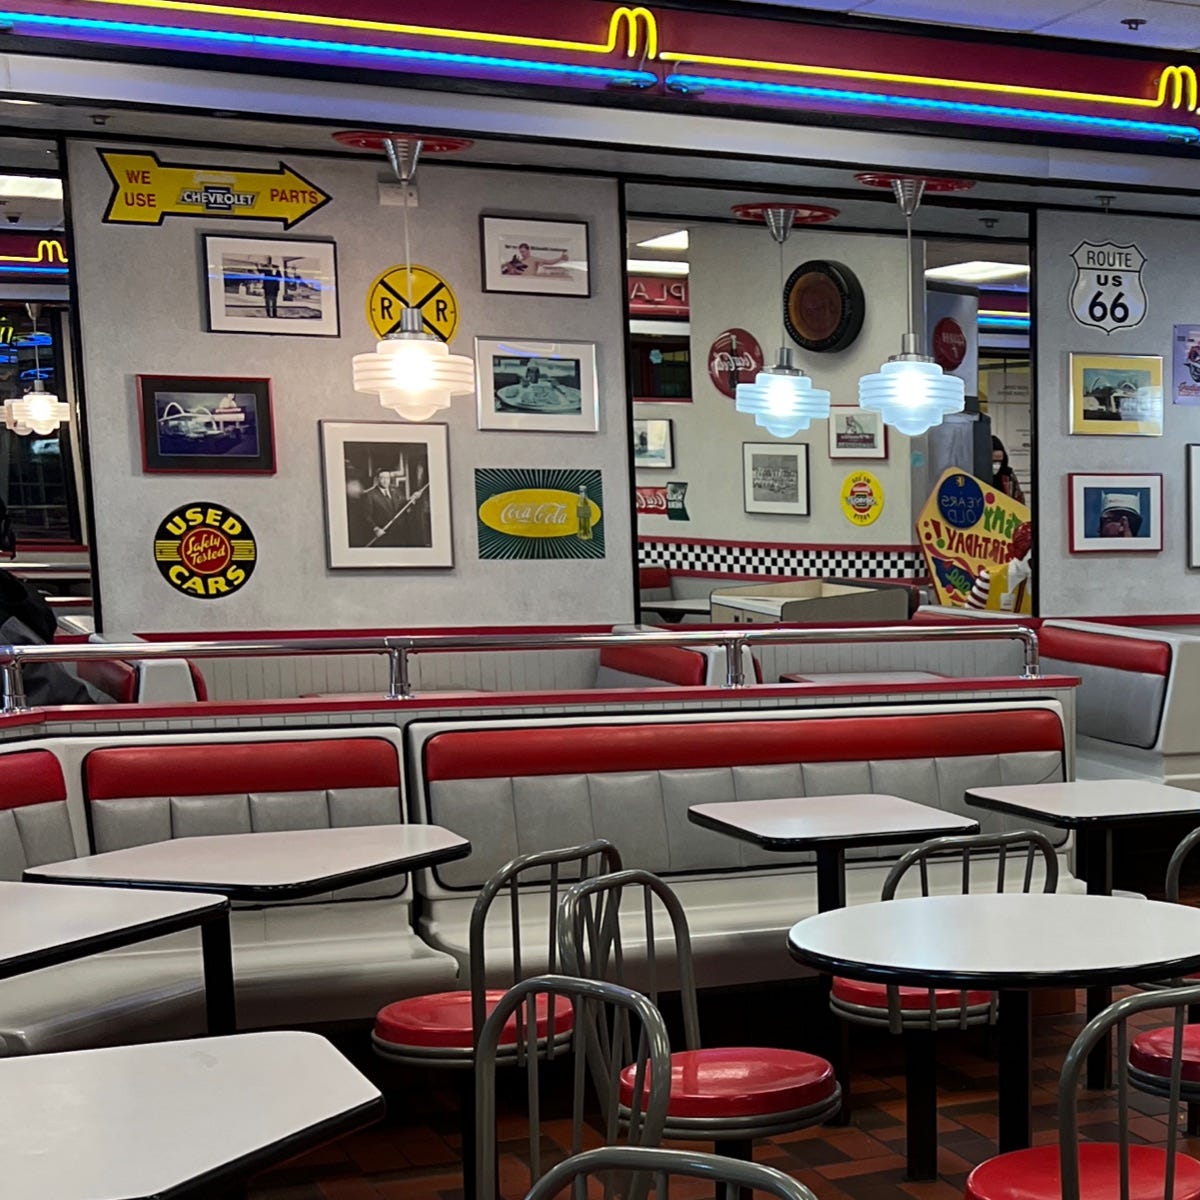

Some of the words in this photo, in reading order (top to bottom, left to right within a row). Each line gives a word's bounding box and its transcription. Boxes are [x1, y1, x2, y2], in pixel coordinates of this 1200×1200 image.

[125, 169, 152, 185] WE
[124, 193, 157, 208] USE
[183, 190, 255, 206] CHEVROLET
[270, 188, 319, 205] PARTS
[1086, 250, 1133, 268] ROUTE
[1096, 274, 1123, 287] US
[380, 296, 394, 321] R
[435, 299, 449, 323] R
[1088, 290, 1130, 324] 66
[165, 507, 242, 536] USED
[186, 533, 221, 555] Safety
[190, 544, 226, 566] Tested
[168, 564, 246, 595] CARS
